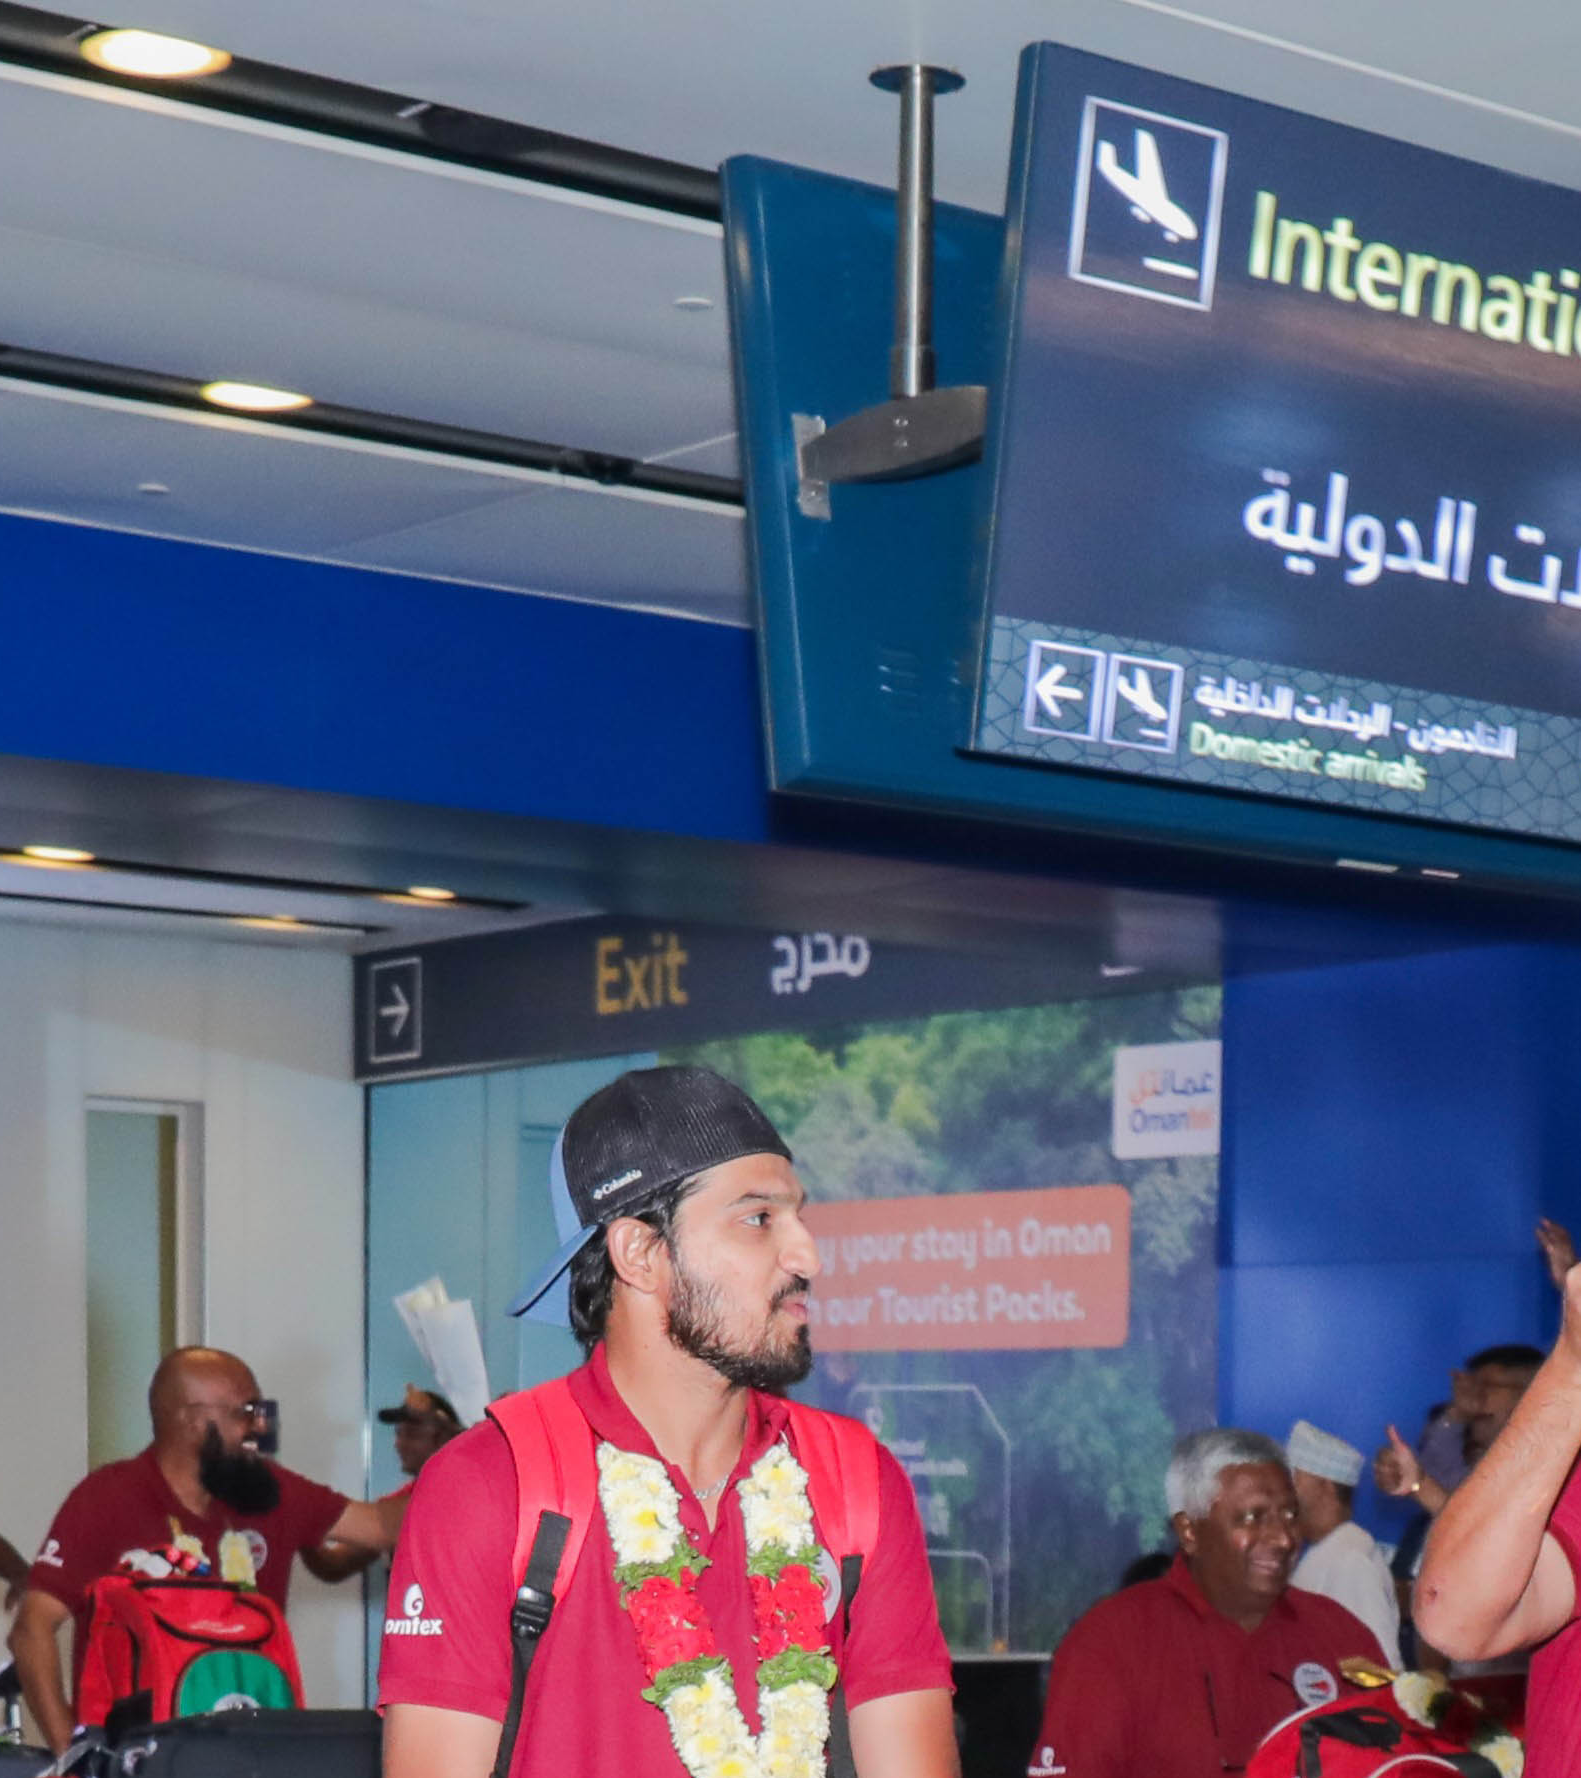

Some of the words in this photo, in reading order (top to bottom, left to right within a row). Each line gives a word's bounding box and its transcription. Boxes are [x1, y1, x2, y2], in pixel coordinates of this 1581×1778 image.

[1244, 468, 1476, 586] الدولية
[1190, 721, 1322, 775] Domestic
[1324, 749, 1426, 791] arrivals
[595, 933, 690, 1016] Exit
[842, 1231, 908, 1275] your
[913, 1223, 980, 1268] stay
[984, 1220, 1013, 1258] in
[1020, 1218, 1111, 1256] Oman
[827, 1297, 874, 1324] our
[878, 1285, 980, 1325] Tourist
[986, 1281, 1085, 1322] Packs.
[385, 1616, 443, 1636] omtex
